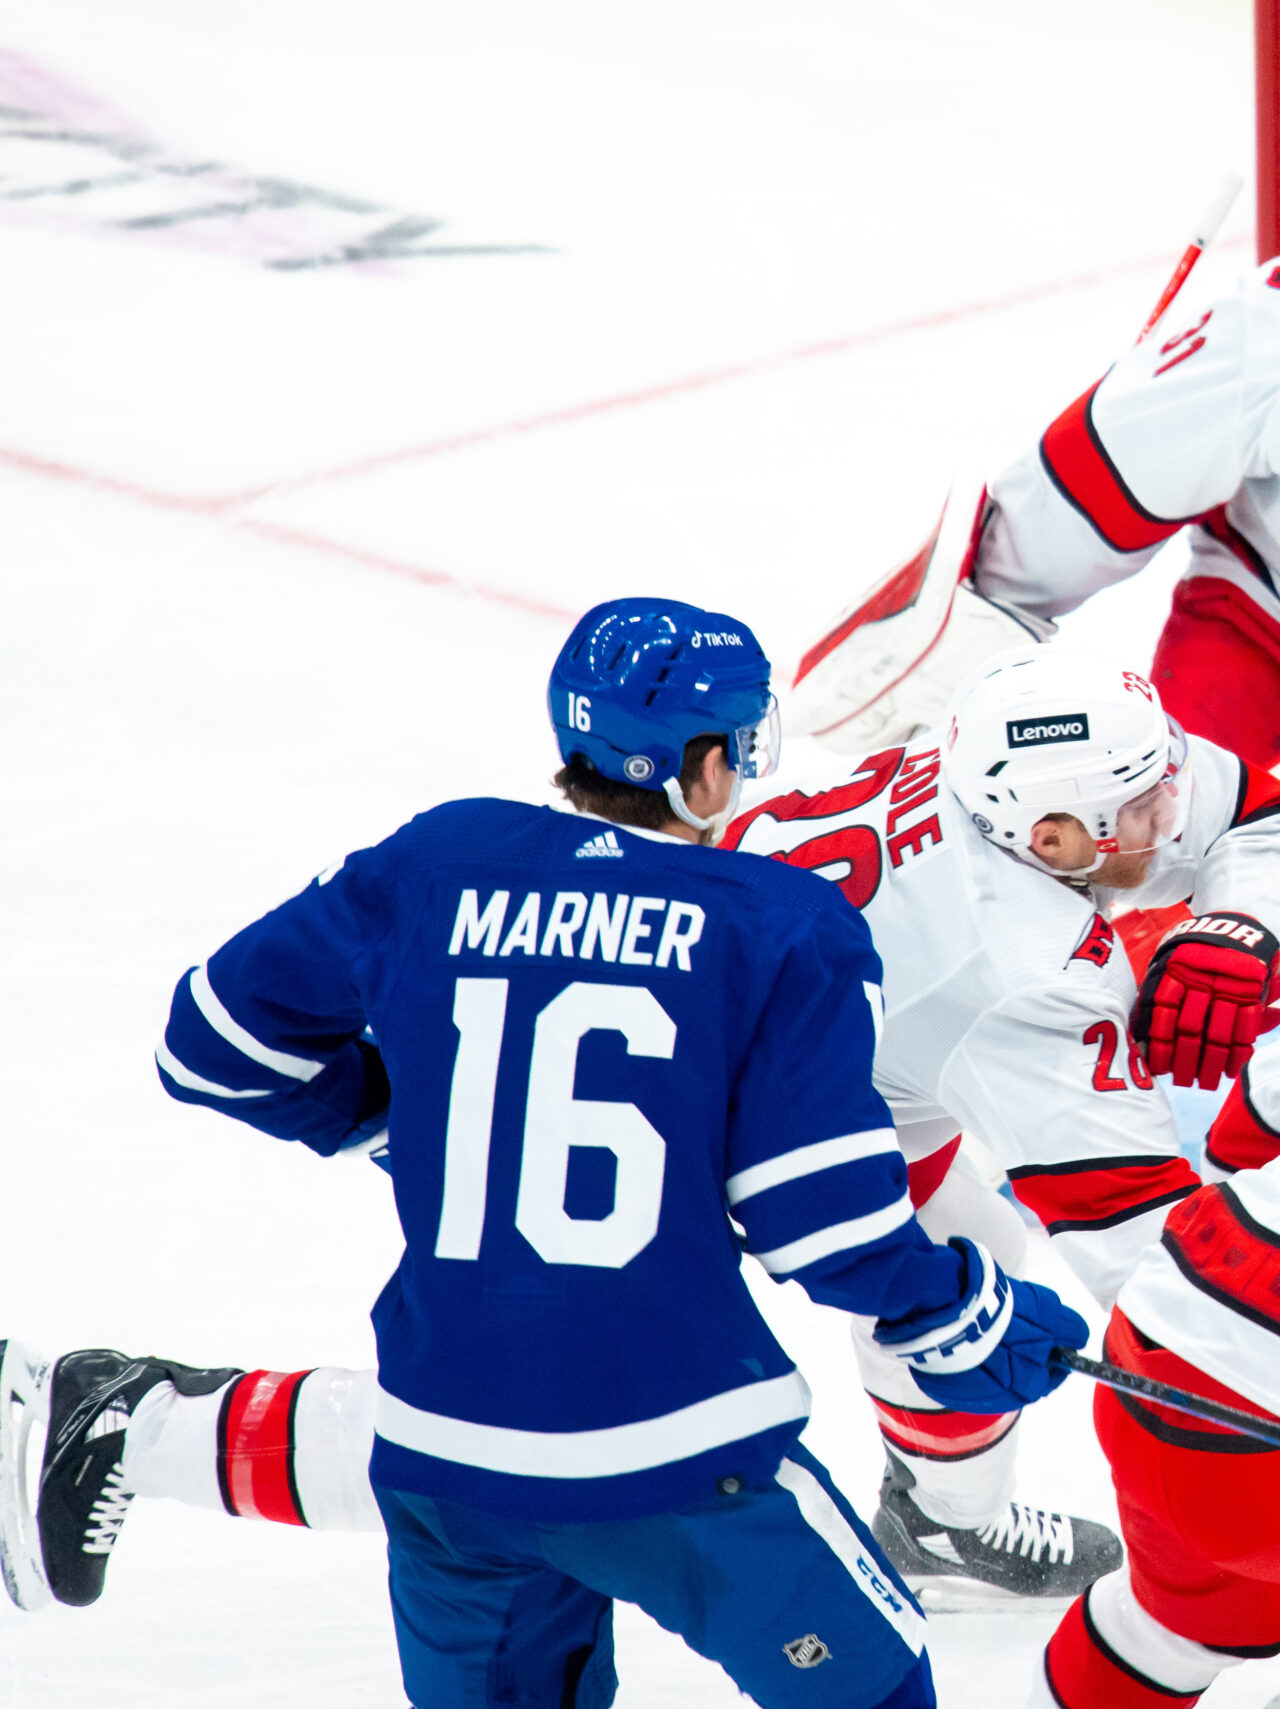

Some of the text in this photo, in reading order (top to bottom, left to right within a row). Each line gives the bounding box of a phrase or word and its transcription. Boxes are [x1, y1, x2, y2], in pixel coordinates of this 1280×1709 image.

[703, 632, 743, 647] TikTok
[567, 692, 591, 732] 16
[1012, 722, 1084, 742] Lenovo
[886, 747, 943, 869] COLE
[448, 889, 706, 972] MARNER
[1160, 917, 1264, 949] RIOR
[434, 977, 678, 1269] 16
